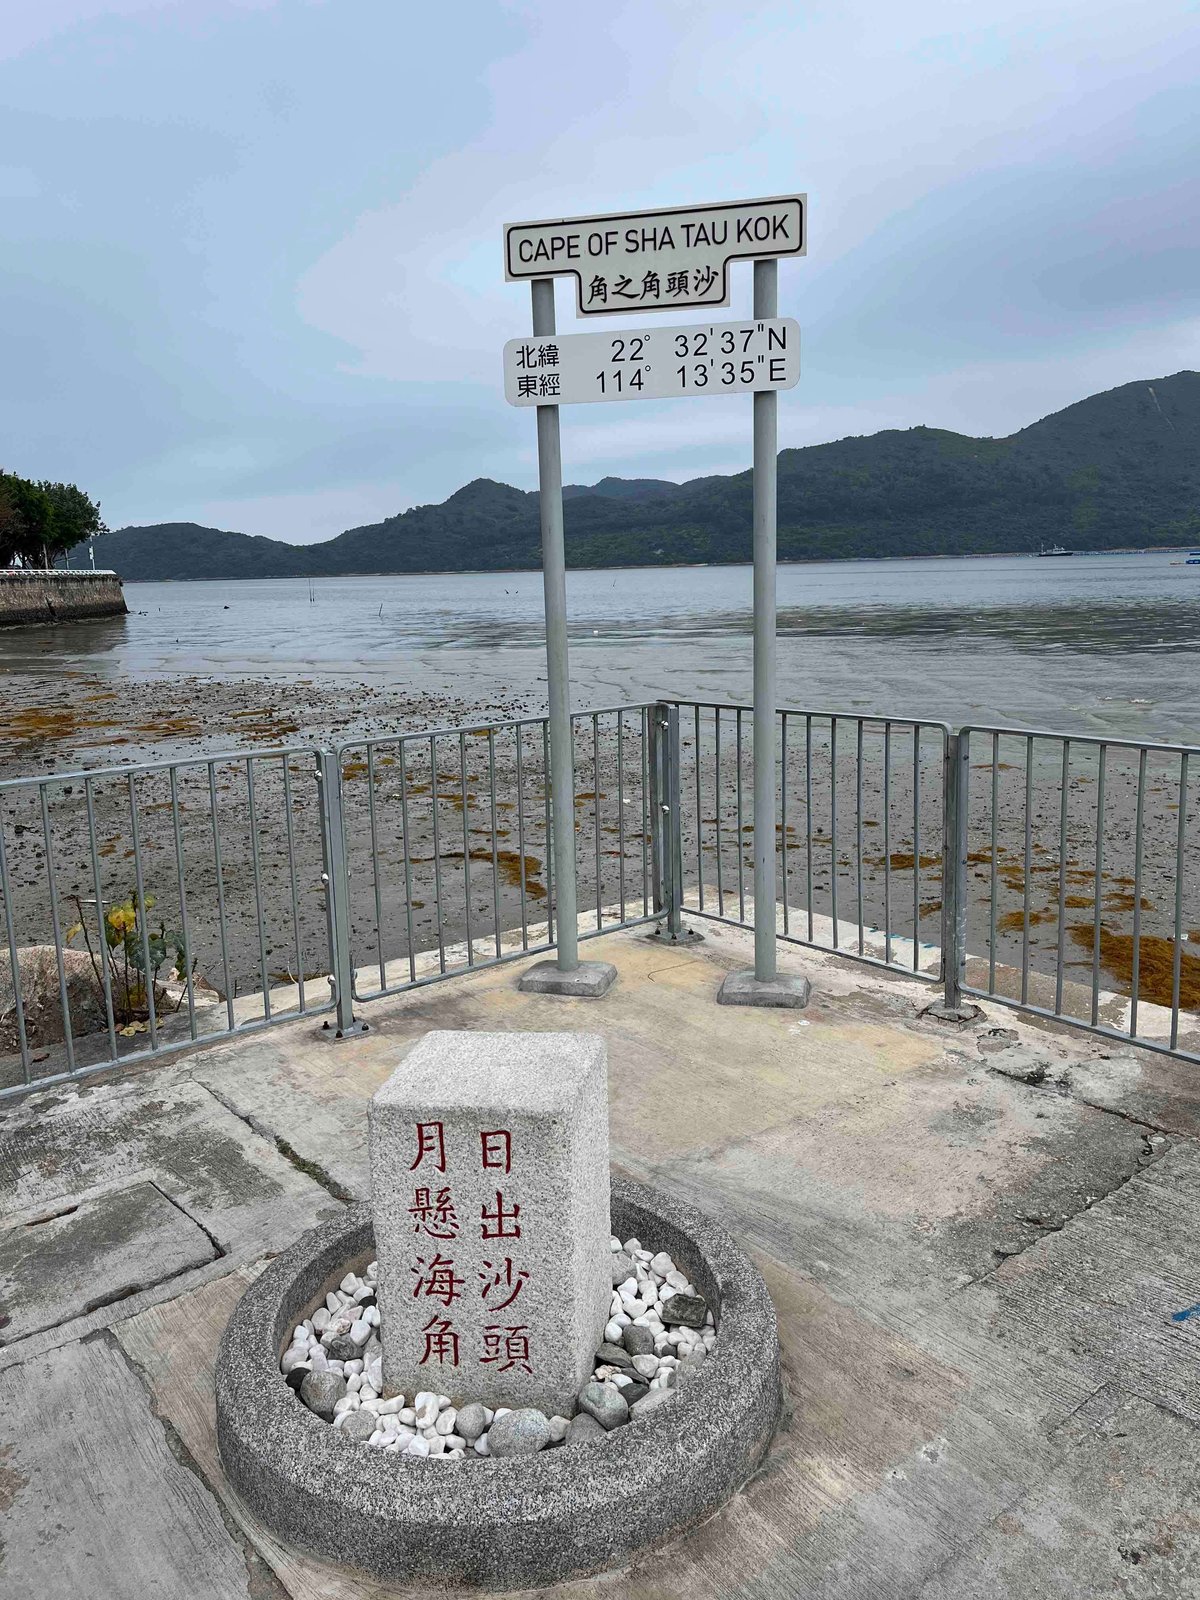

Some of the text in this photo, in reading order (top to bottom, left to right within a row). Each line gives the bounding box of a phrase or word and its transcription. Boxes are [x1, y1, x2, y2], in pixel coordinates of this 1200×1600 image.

[518, 214, 790, 263] CAPE OF SHA TAU KOK
[516, 344, 560, 369] 北緯
[611, 334, 651, 362] 22°
[517, 373, 561, 398] 東經
[596, 365, 651, 394] 114°
[408, 1121, 466, 1368] 月懸海角
[478, 1129, 533, 1375] 日出沙頭
